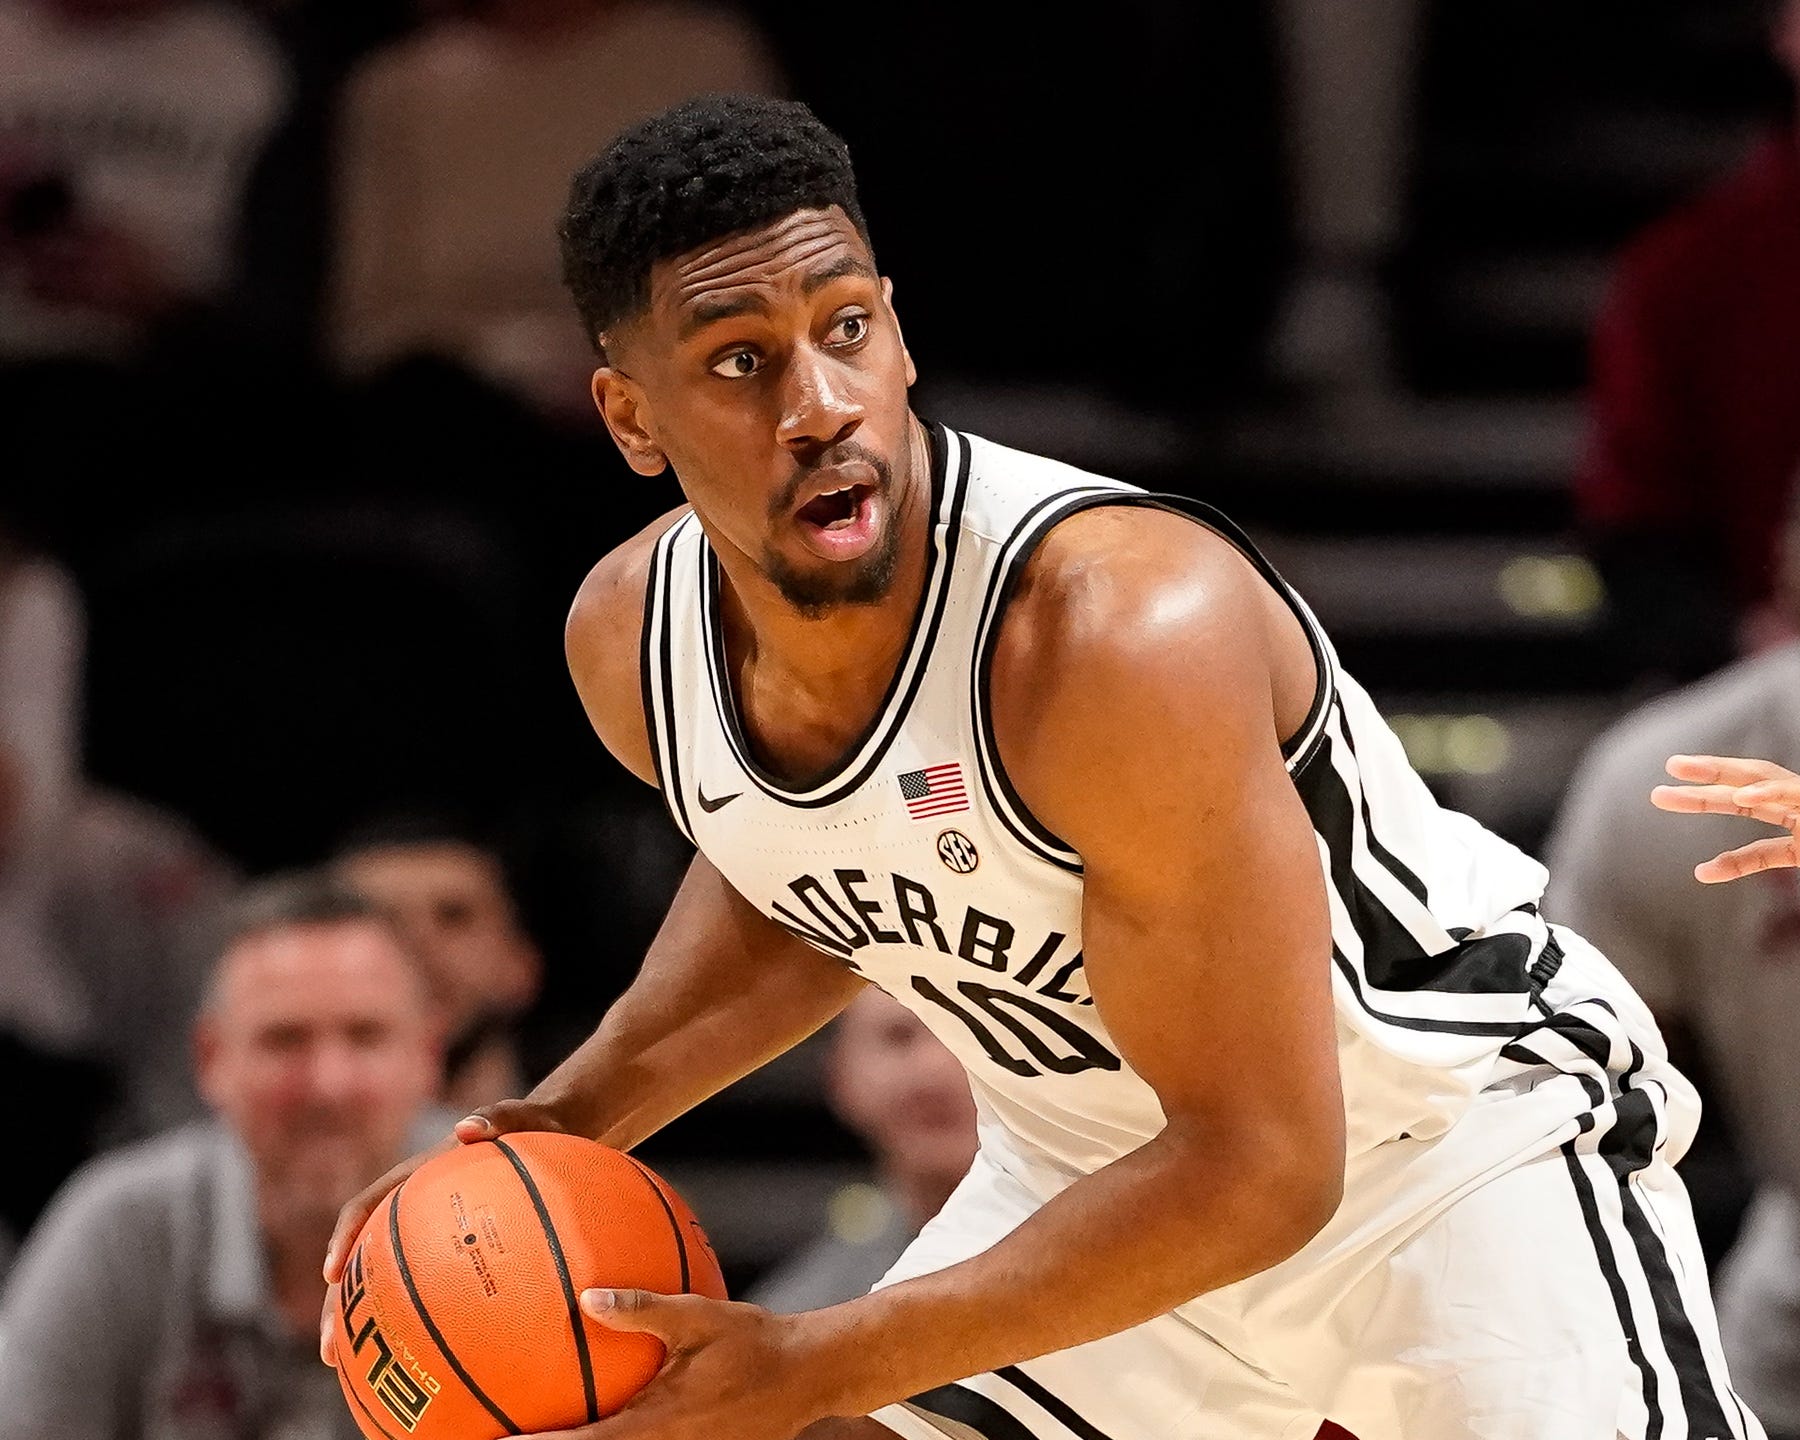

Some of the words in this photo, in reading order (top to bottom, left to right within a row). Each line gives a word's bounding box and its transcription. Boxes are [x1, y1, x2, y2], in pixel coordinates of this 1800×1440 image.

[938, 830, 979, 874] SEC
[771, 869, 1094, 1006] NDERBIL
[911, 975, 1121, 1078] 10
[342, 1242, 434, 1434] ELITE
